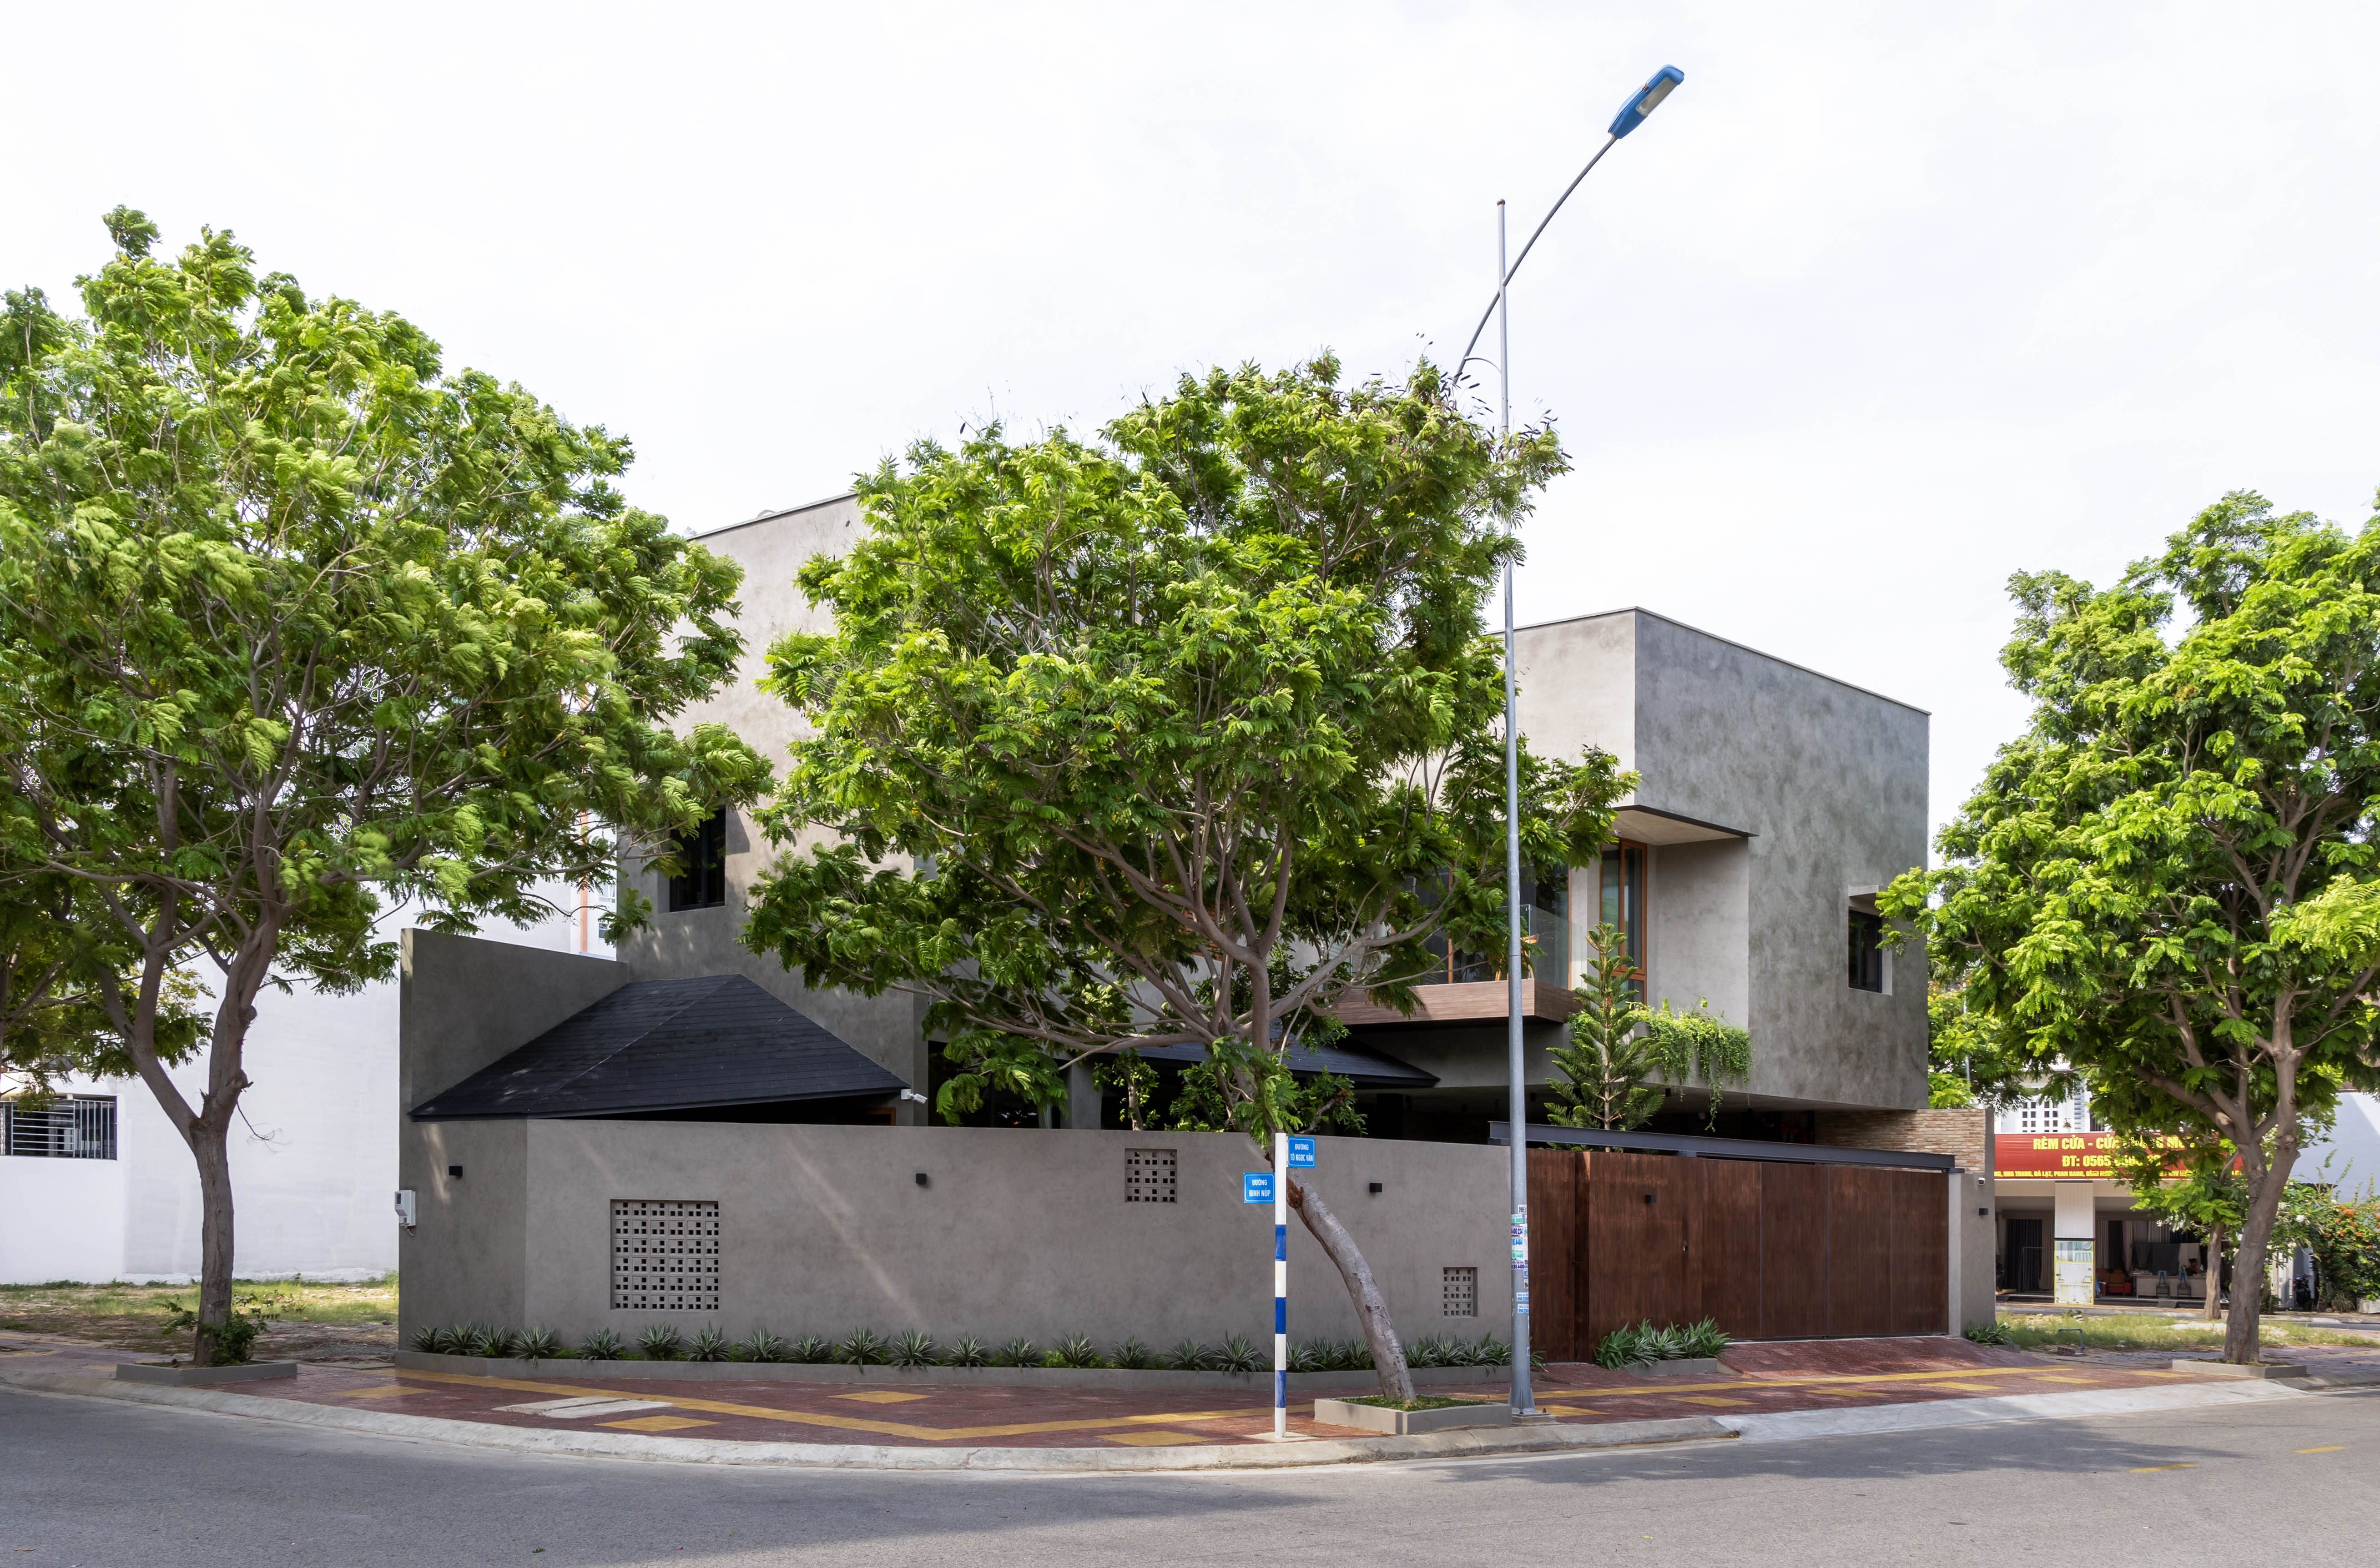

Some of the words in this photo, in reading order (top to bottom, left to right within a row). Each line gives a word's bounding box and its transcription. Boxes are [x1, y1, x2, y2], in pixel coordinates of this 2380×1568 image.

[2033, 1136, 2059, 1150] RÈM
[2062, 1134, 2085, 1150] CỬA
[1290, 1152, 1295, 1161] TÔ
[1295, 1154, 1306, 1163] NGỌC
[2062, 1155, 2080, 1167] ĐT:
[2082, 1155, 2111, 1167] 0565
[1252, 1178, 1267, 1186] ĐƯỜNG
[1261, 1188, 1271, 1197] NÚP
